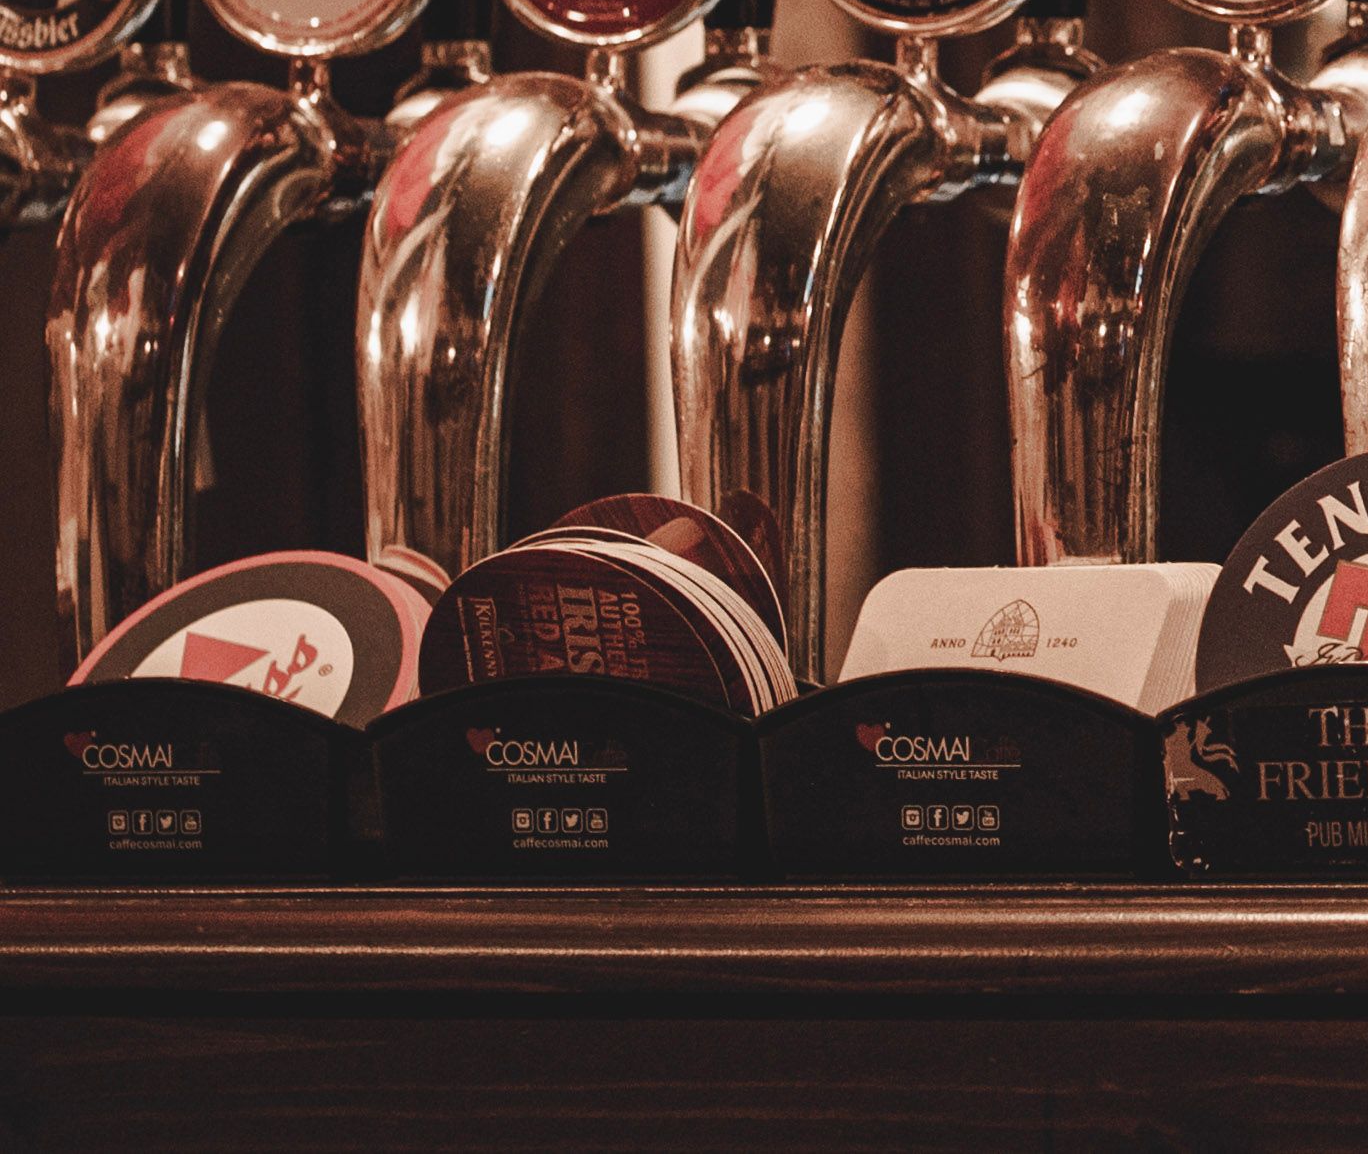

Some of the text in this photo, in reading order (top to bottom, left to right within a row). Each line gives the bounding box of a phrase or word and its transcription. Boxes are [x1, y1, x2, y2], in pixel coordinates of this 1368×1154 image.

[529, 586, 561, 642] RED
[620, 590, 647, 649] 100%
[474, 604, 498, 678] KILKENNY
[930, 636, 1079, 649] ANNO 1240
[82, 743, 173, 769] COSMAI
[485, 740, 579, 766] COSMAI
[875, 735, 970, 763] COSMAI
[103, 775, 201, 786] ITALIAN STYLE TASTE
[507, 772, 607, 784] ITALIAN STYLE TASTE
[897, 768, 999, 781] ITALIAN STYLE TASTE
[109, 837, 203, 851] caffecosmai.com
[512, 836, 609, 849] caffecosmai.com
[902, 832, 1001, 847] caffecosmai.com
[1306, 820, 1343, 848] PUB
